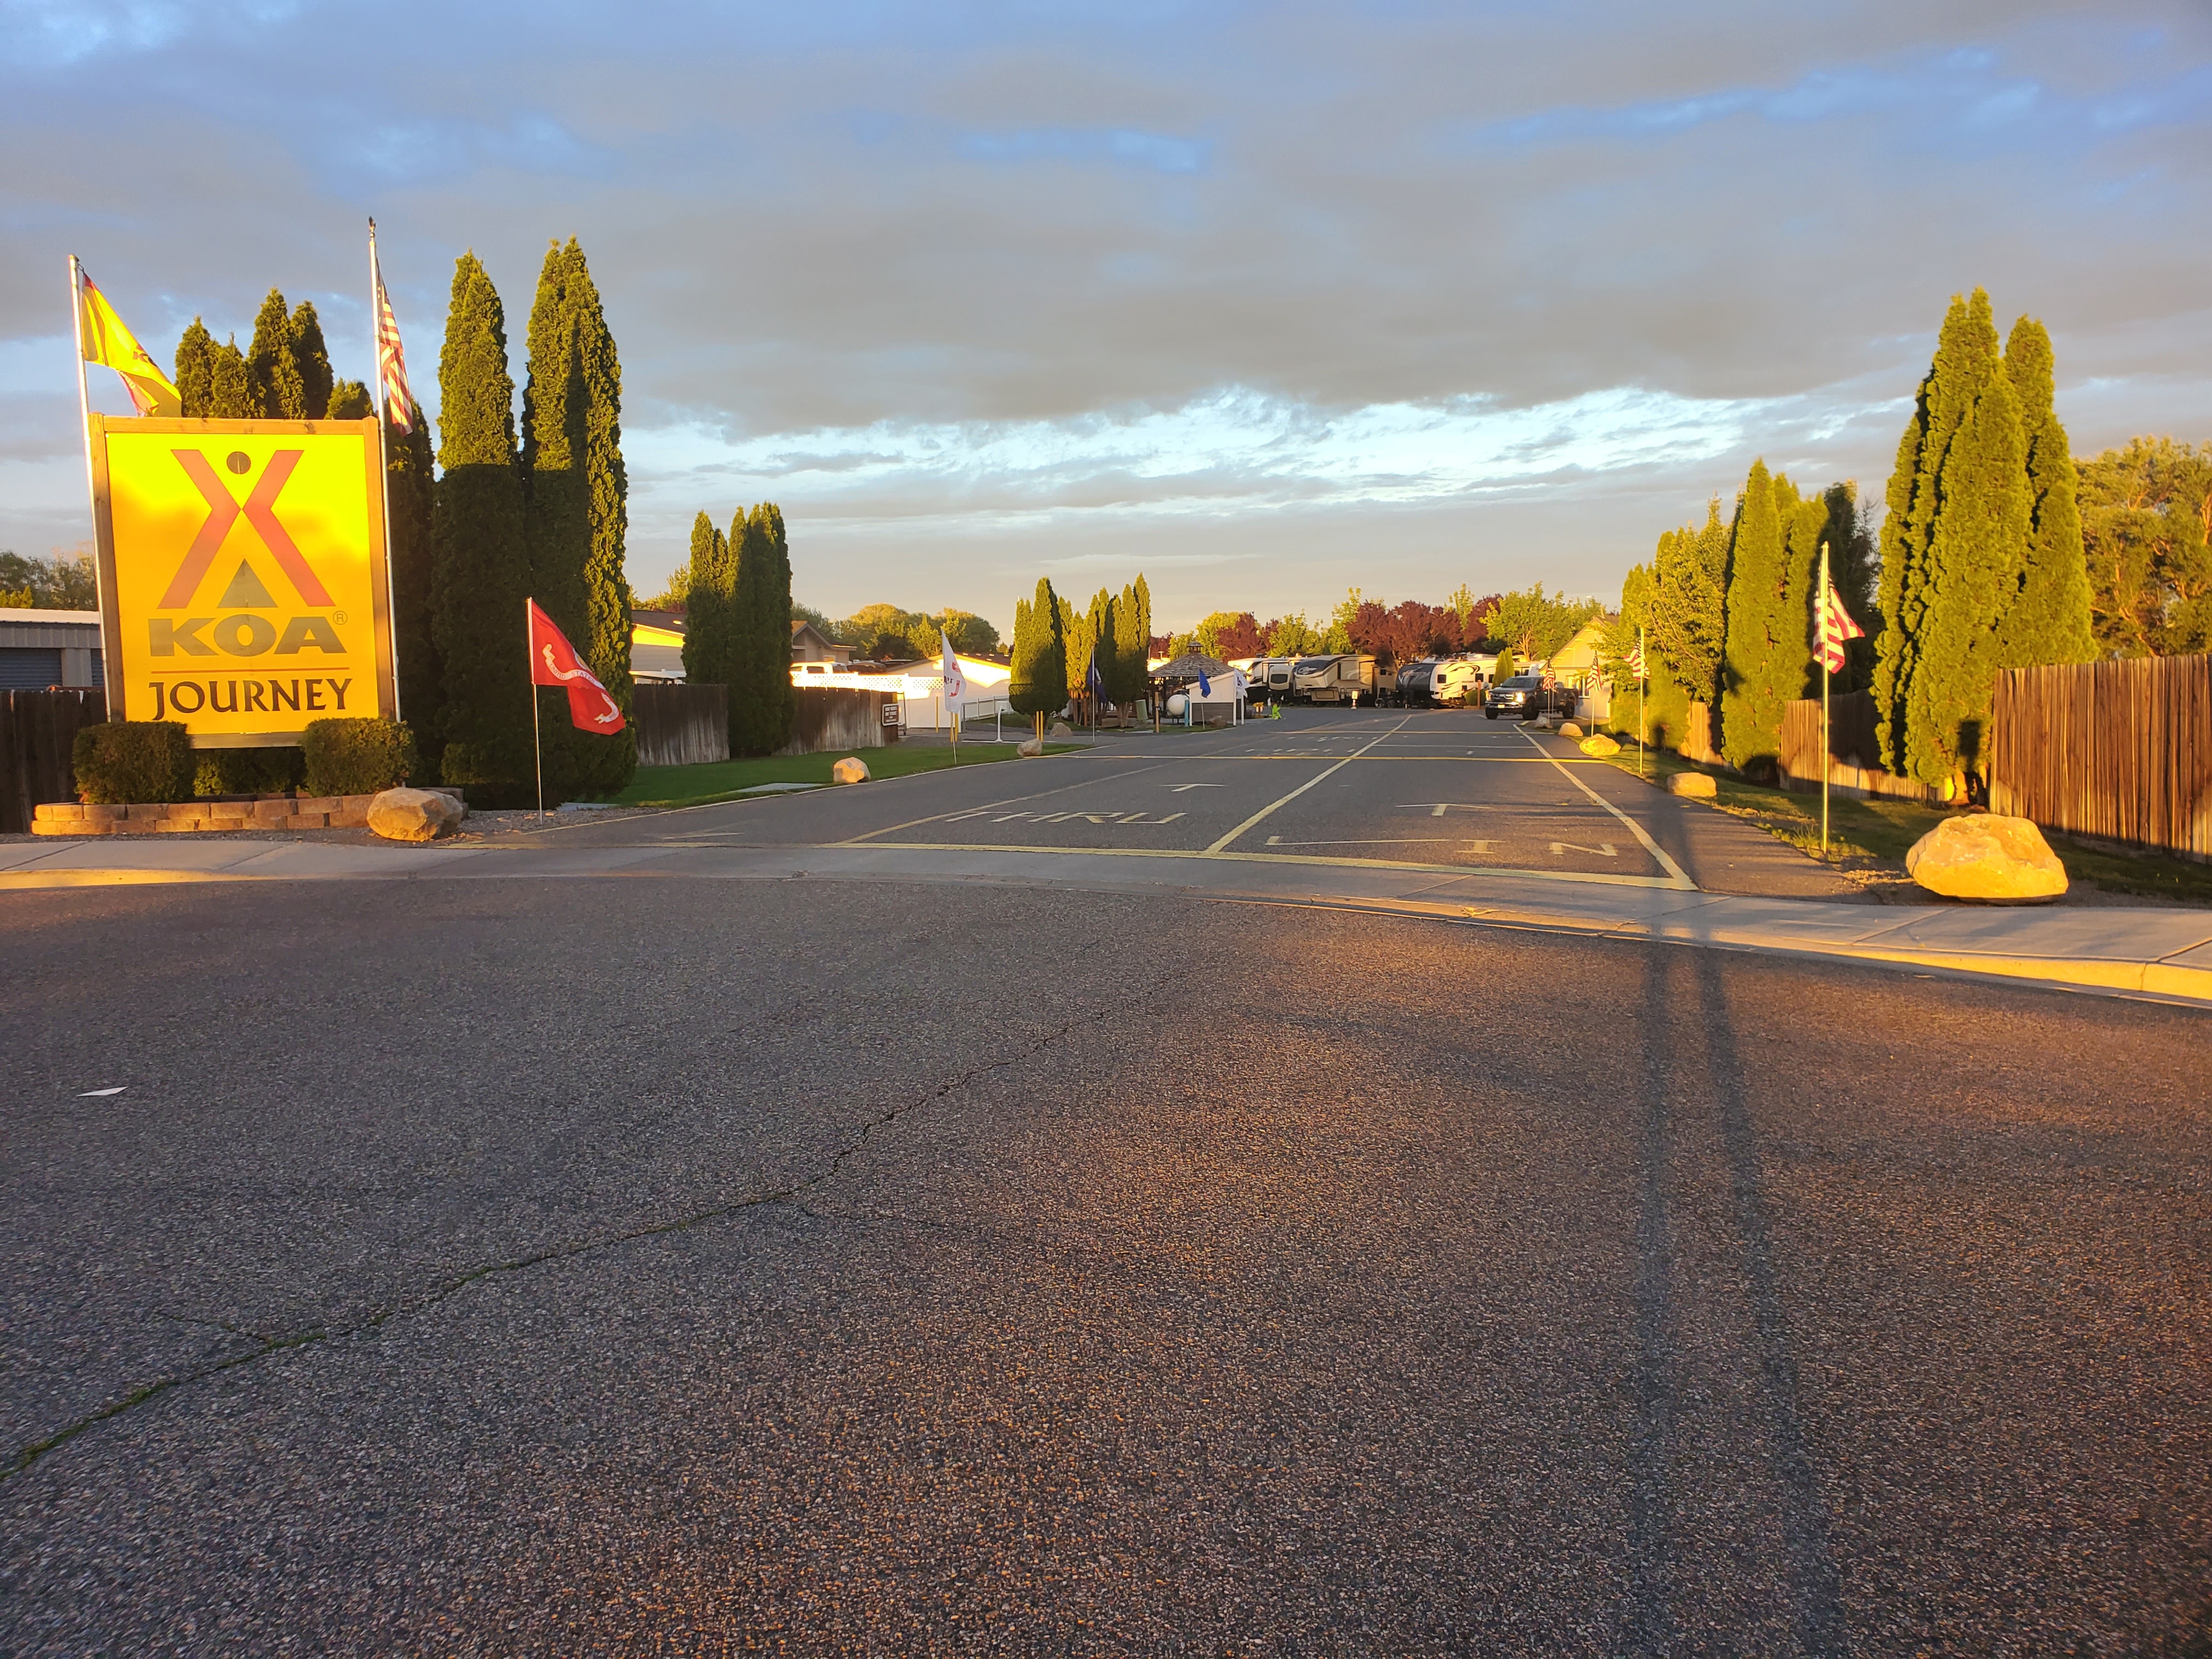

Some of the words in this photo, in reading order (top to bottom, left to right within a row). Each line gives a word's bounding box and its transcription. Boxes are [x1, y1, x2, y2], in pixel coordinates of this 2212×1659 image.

[148, 614, 347, 657] KOA
[550, 663, 566, 679] UNITED
[149, 678, 353, 720] JOURNEY
[945, 811, 1187, 823] THRU
[1457, 839, 1617, 856] IN
